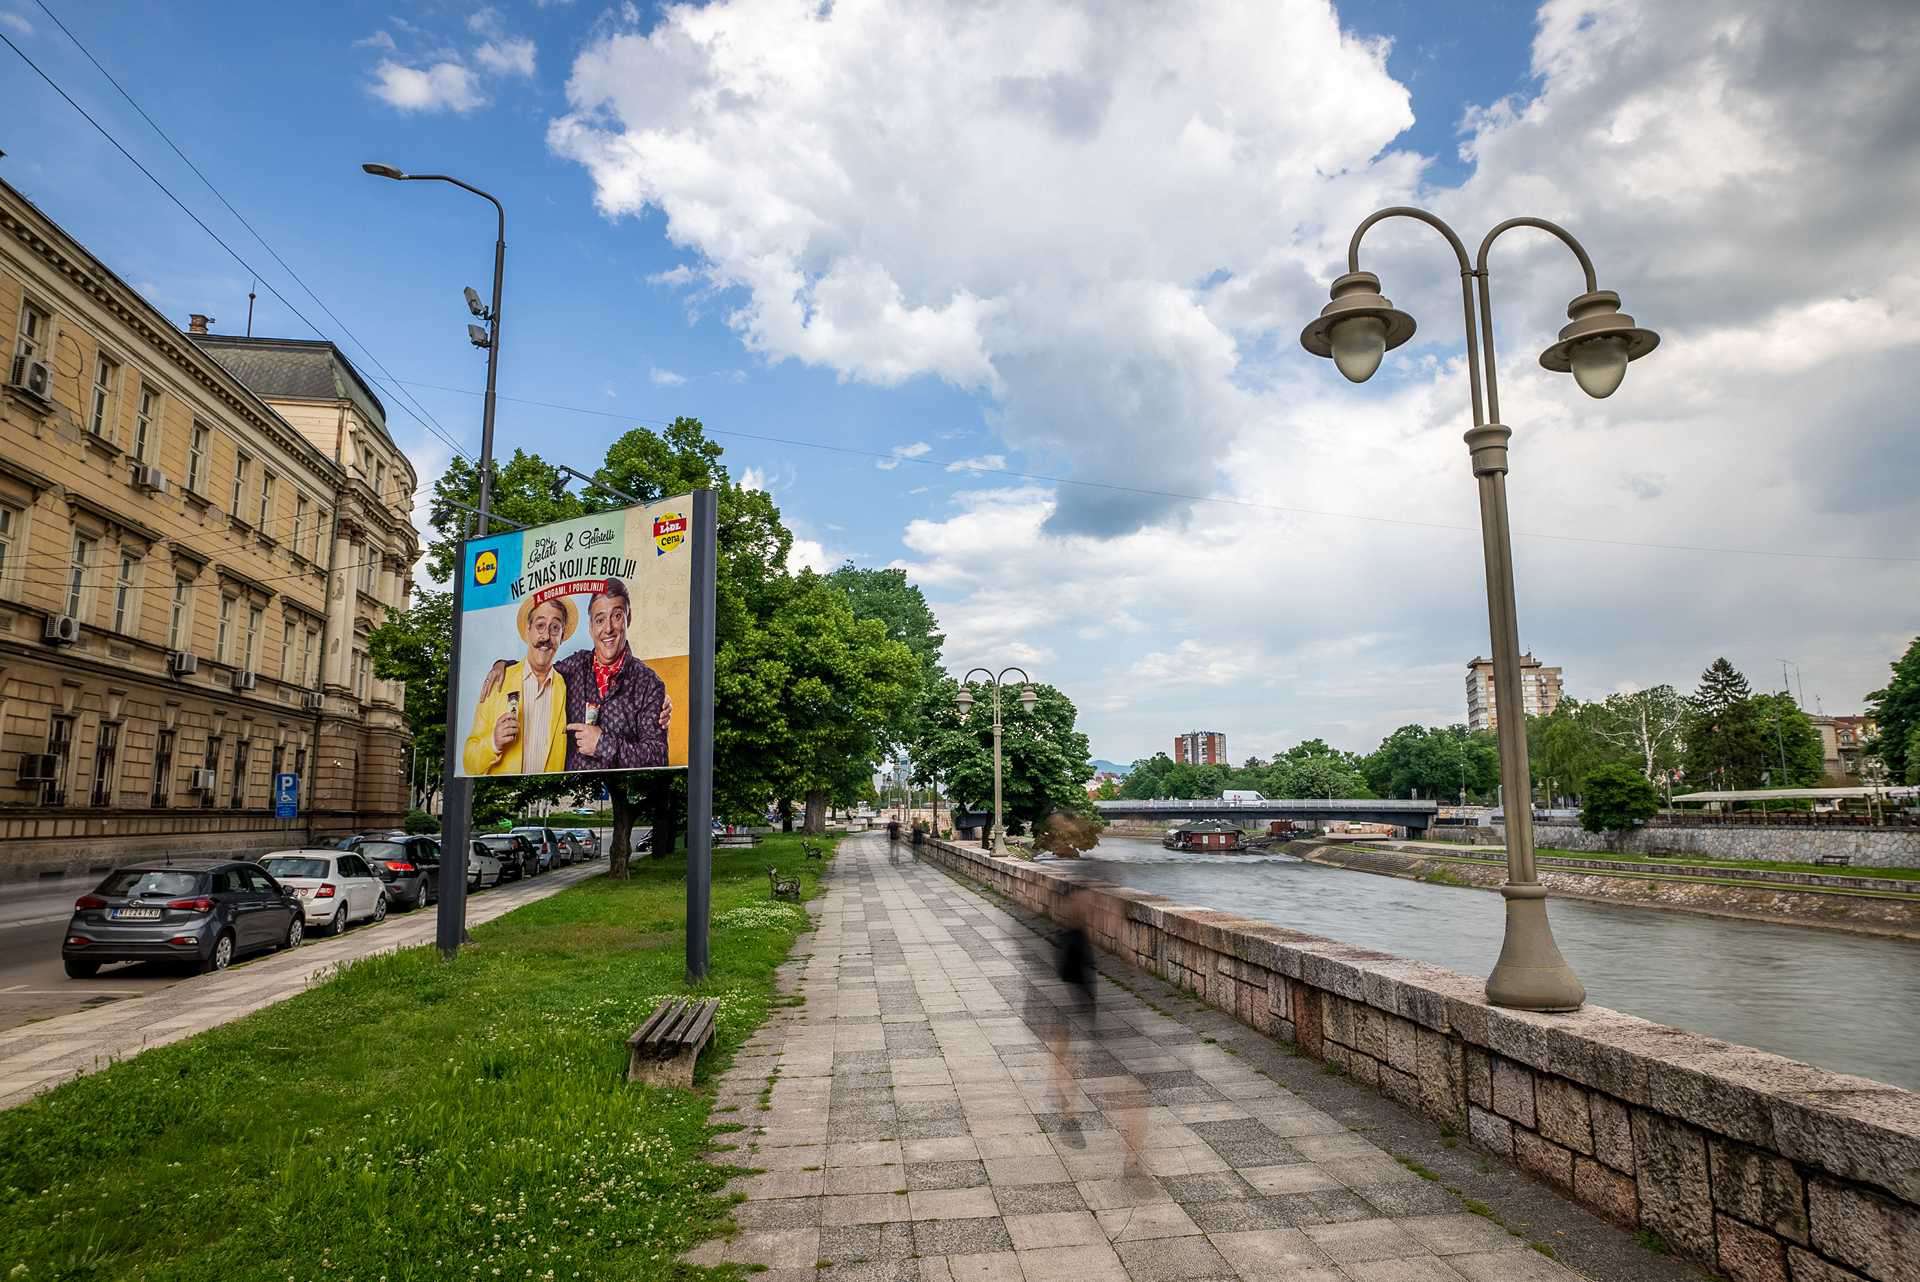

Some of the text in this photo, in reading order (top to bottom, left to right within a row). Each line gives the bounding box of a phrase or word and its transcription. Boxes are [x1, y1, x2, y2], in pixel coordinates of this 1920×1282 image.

[528, 540, 557, 569] Gelati
[564, 532, 573, 552] &
[536, 536, 550, 547] BON
[511, 556, 637, 600] NE ZNAŠ KOJI JE BOLJI!
[282, 776, 293, 791] P
